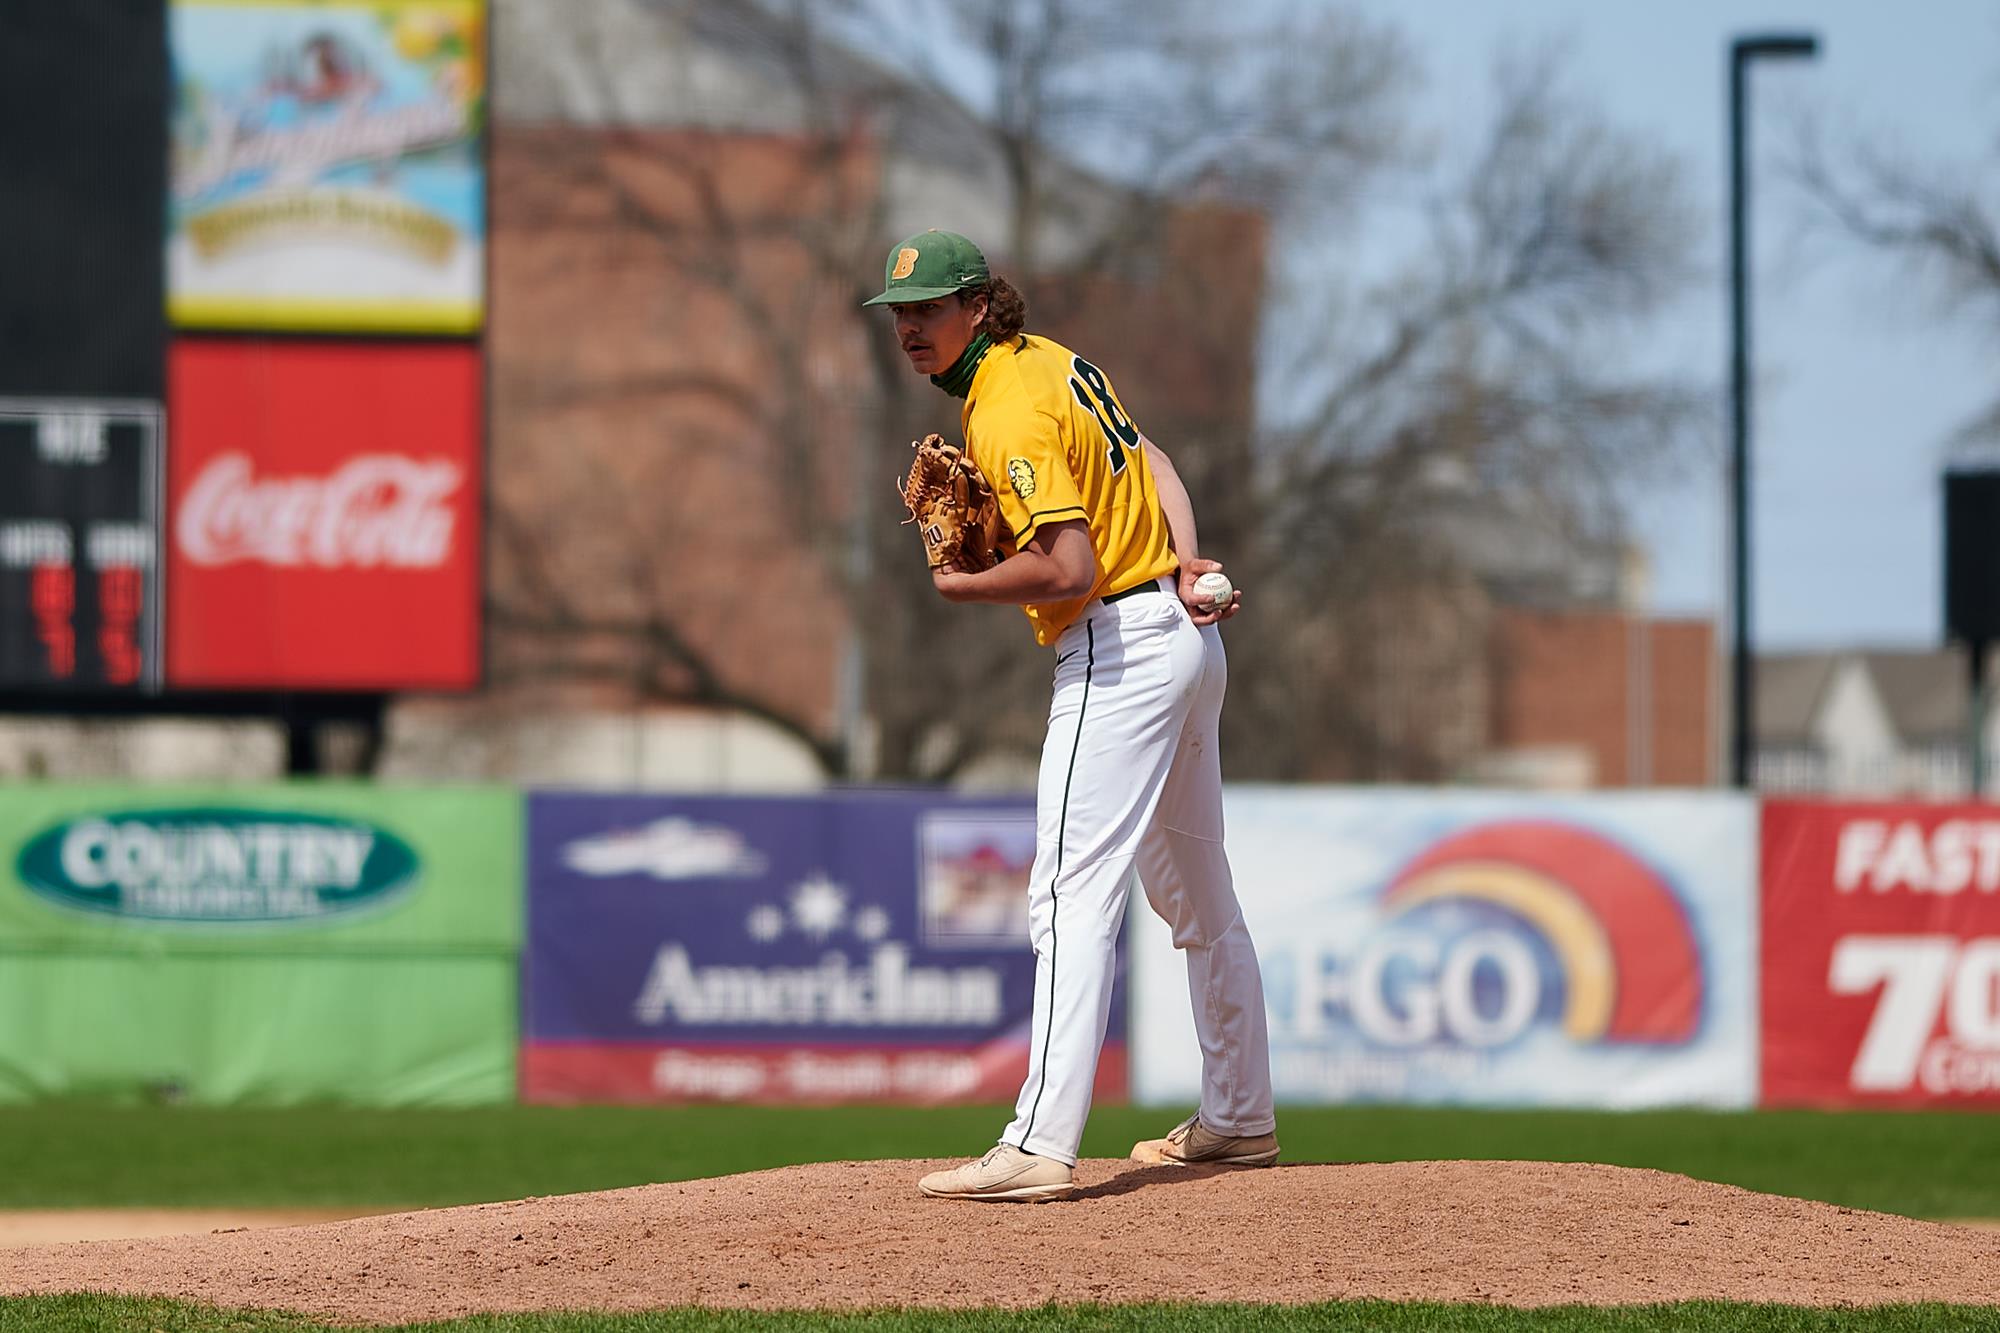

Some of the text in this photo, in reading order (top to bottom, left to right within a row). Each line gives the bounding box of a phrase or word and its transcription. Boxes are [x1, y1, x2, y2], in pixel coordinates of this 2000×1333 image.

[892, 248, 919, 280] B
[1068, 355, 1141, 477] 18
[61, 818, 375, 889] COUNTRY
